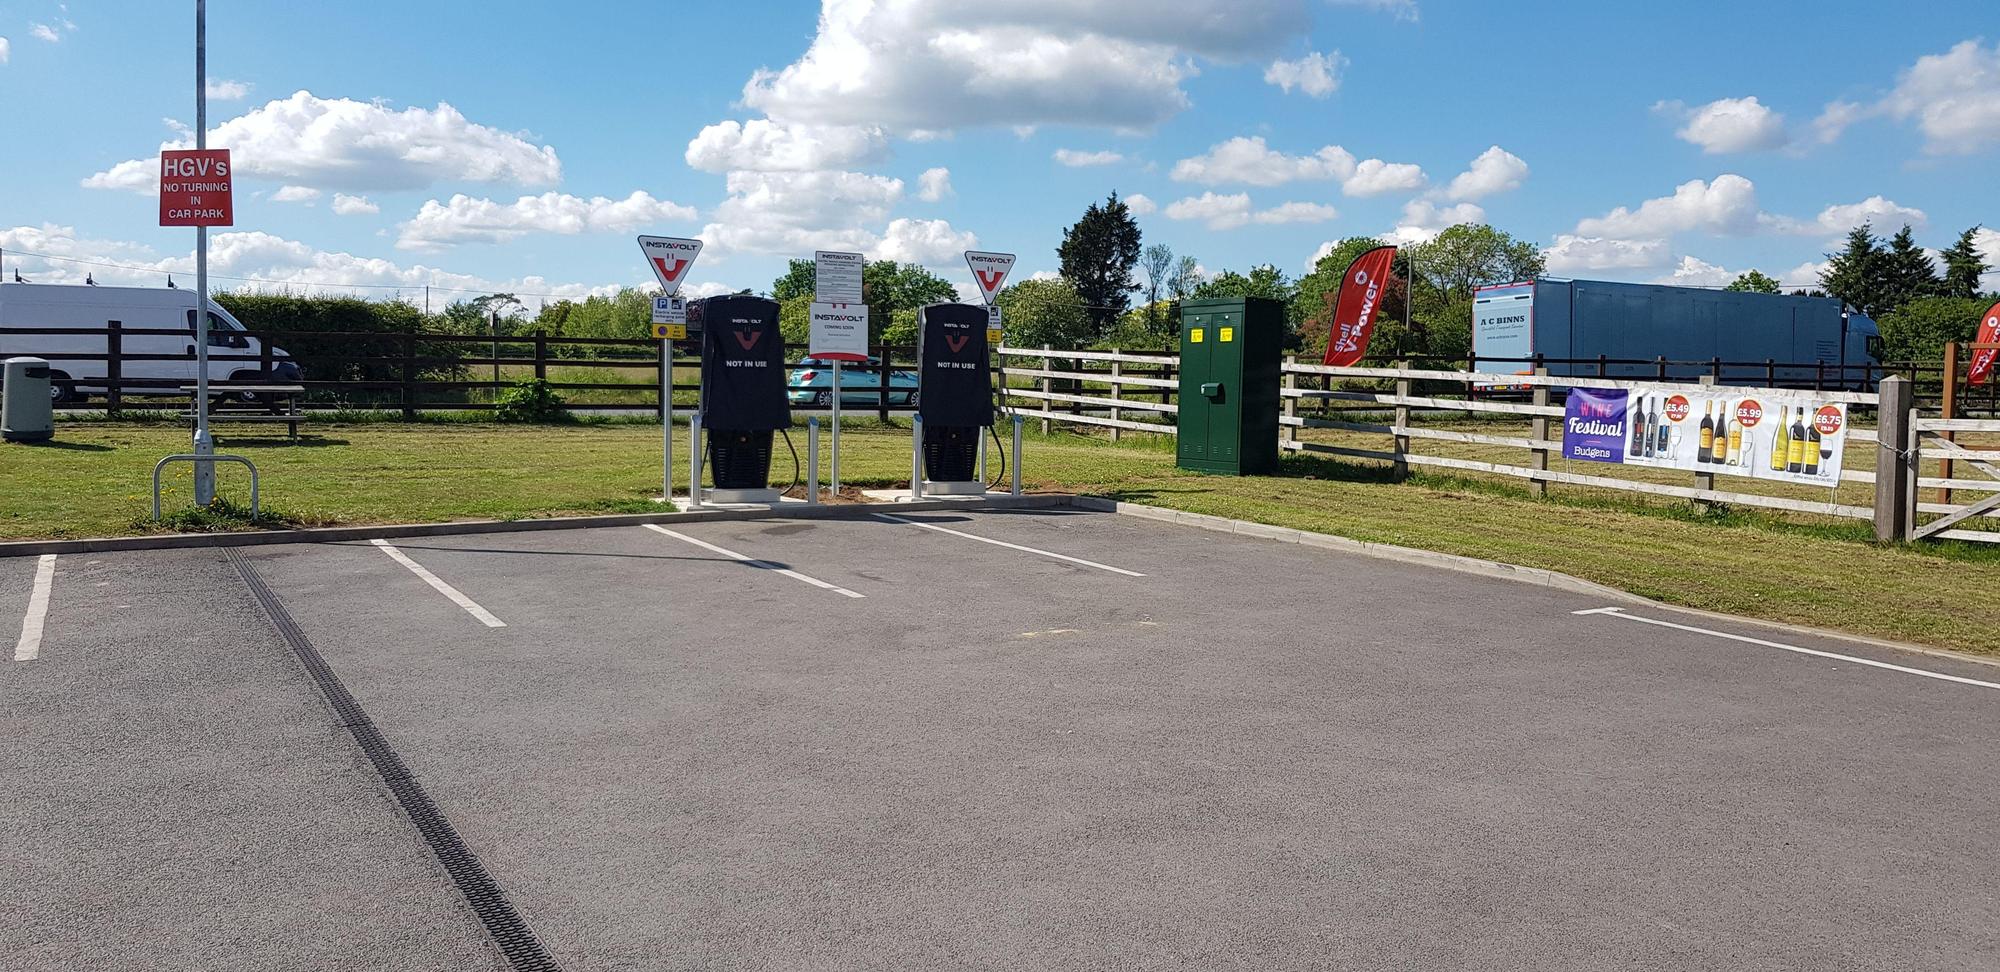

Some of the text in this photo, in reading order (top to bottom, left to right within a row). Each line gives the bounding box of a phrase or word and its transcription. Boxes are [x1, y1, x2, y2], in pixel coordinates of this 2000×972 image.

[164, 158, 228, 177] HGV's
[163, 182, 228, 192] NO TURNING
[190, 196, 201, 205] IN
[168, 208, 224, 218] CAR PARK
[646, 241, 698, 250] INSTAVOLT
[971, 256, 1012, 264] INSTAVOLT
[814, 314, 864, 322] INSTAVOLT
[1343, 280, 1378, 353] V-Power
[1496, 315, 1525, 324] BINNS
[1334, 323, 1351, 352] Shell
[1580, 402, 1614, 418] WINE
[1666, 403, 1689, 413] £5.49
[1737, 408, 1762, 418] £5.99
[1816, 415, 1842, 425] £6.75
[1568, 416, 1623, 437] Festival
[1574, 446, 1610, 458] Budgens
